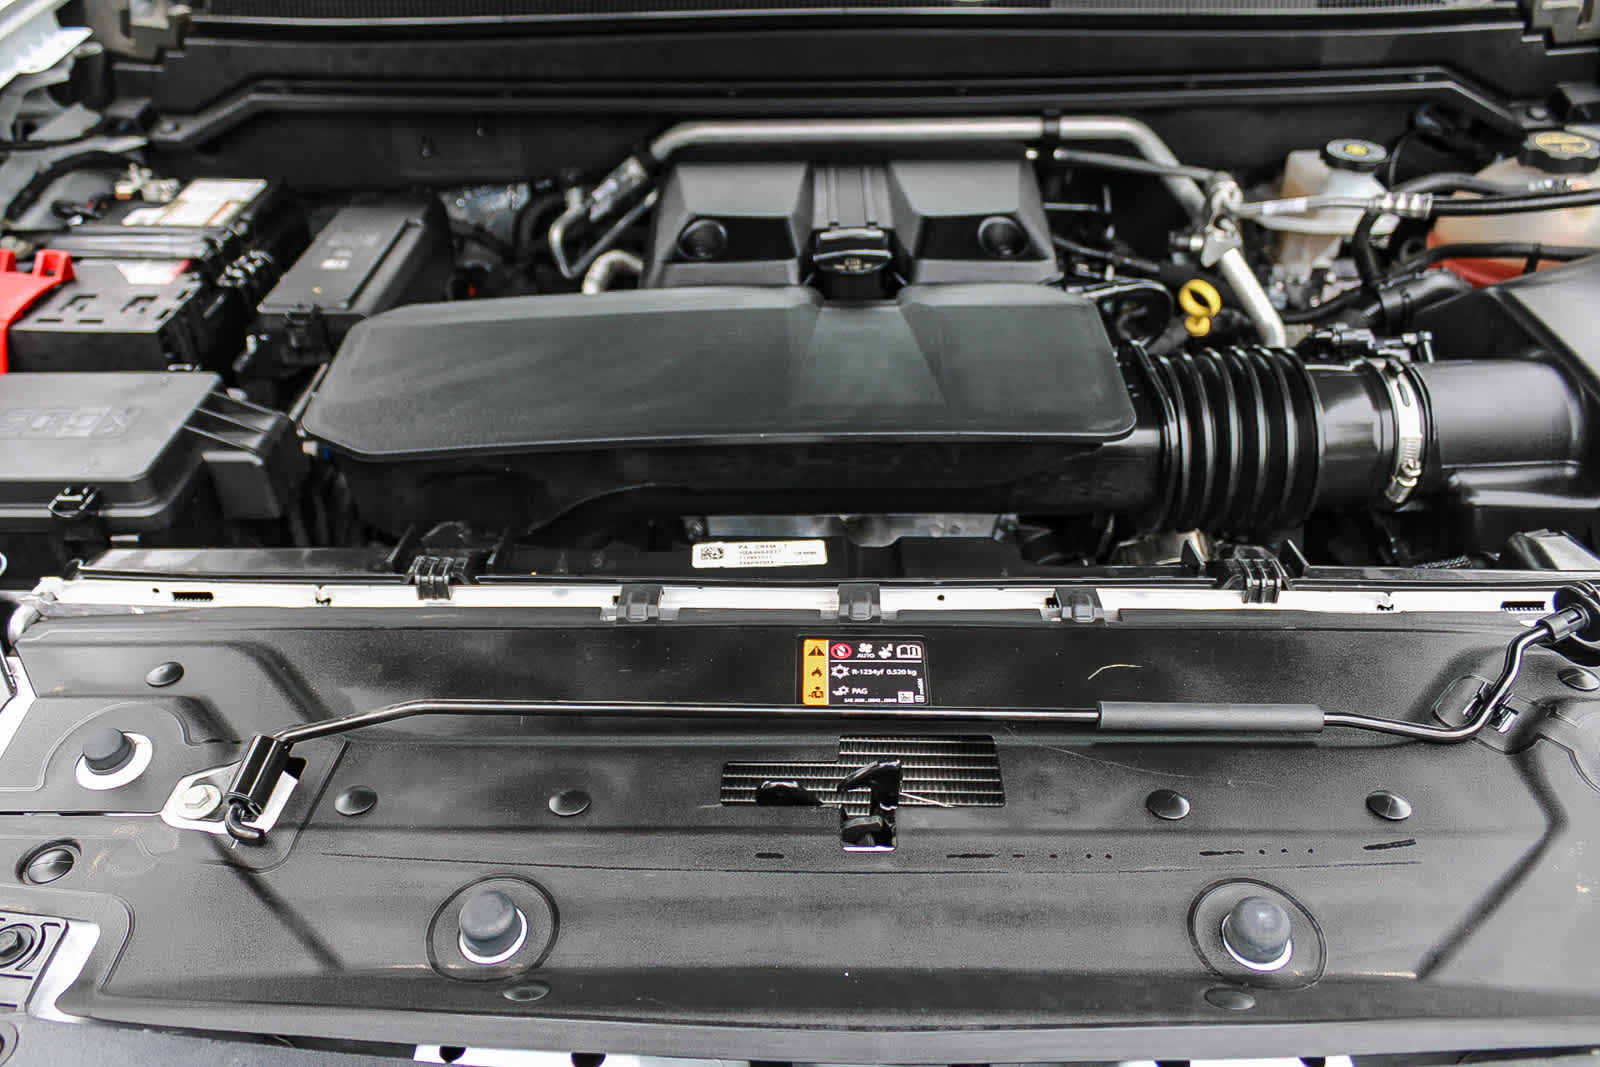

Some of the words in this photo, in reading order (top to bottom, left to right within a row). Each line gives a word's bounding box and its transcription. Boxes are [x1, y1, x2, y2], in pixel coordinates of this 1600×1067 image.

[851, 668, 884, 677] R-1234yf
[886, 668, 907, 676] 0.520
[907, 668, 918, 677] kg
[851, 687, 869, 695] PAG
